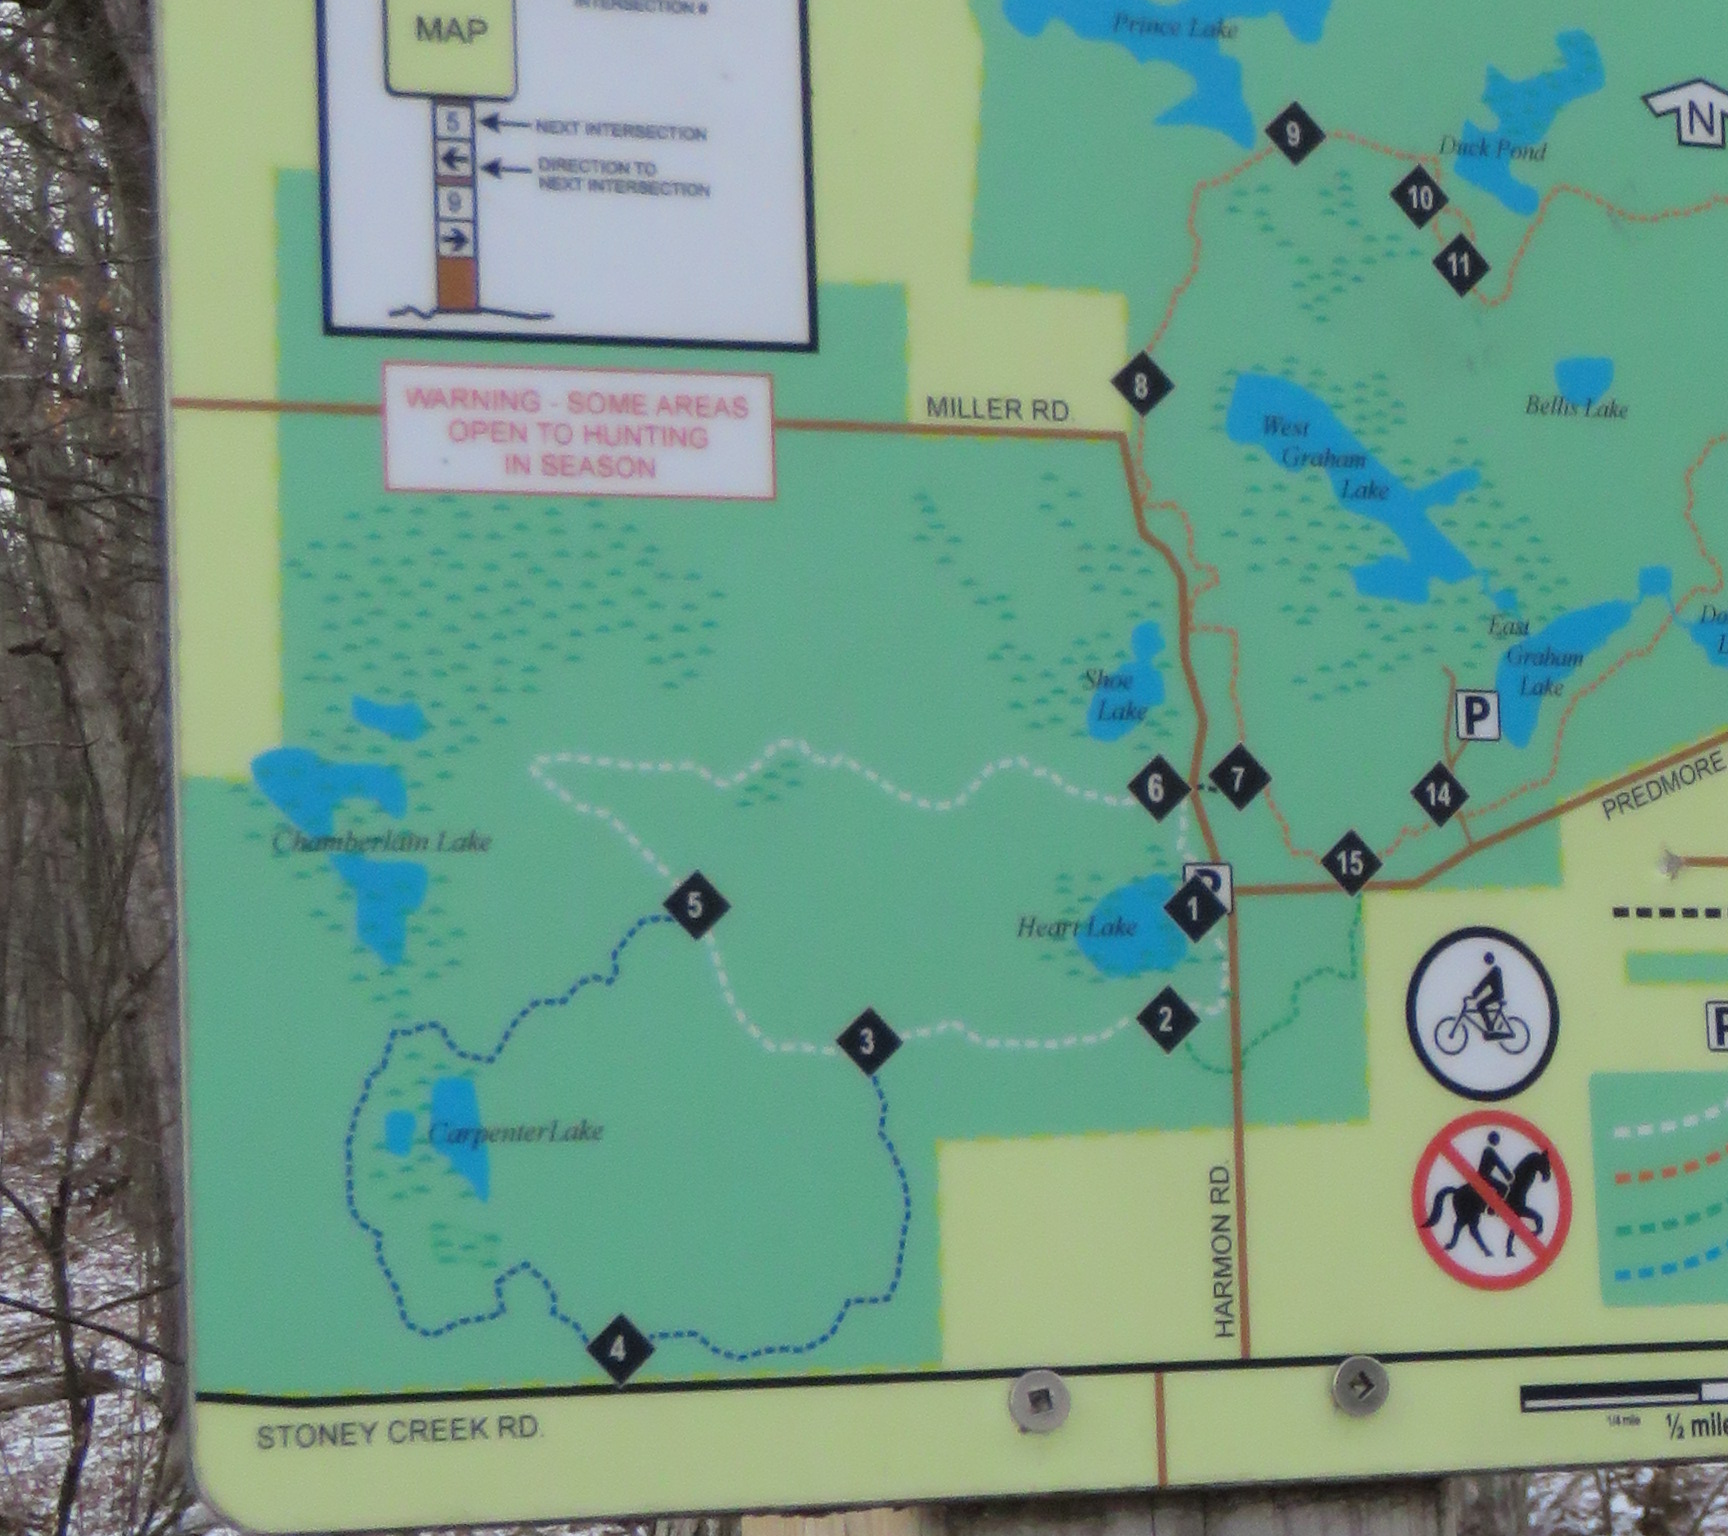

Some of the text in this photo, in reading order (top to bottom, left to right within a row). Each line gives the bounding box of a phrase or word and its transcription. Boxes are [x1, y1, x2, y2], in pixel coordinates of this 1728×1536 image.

[415, 15, 489, 45] MAP
[1111, 11, 1239, 40] Prince Lake
[445, 111, 460, 133] 5
[536, 119, 708, 141] NEXT INTERSECTION
[1688, 100, 1715, 136] N
[1287, 120, 1301, 147] 9
[1496, 138, 1548, 162] Pond
[538, 156, 658, 177] DIRECTION TO
[538, 176, 711, 198] NEXT INTERSECTION
[1407, 185, 1433, 211] 10
[1447, 252, 1470, 277] 11
[1134, 373, 1148, 400] 8
[405, 387, 542, 414] WARNING
[567, 390, 648, 416] SOME
[655, 394, 749, 419] AREAS
[926, 395, 1024, 421] MILLER
[1584, 396, 1630, 420] Lake
[447, 418, 710, 450] OPEN TO HUNTING
[1262, 413, 1311, 439] West
[505, 453, 657, 480] IN SEASON
[1281, 446, 1367, 471] Graham
[1341, 478, 1390, 501] Lake
[1489, 613, 1531, 636] East
[1506, 645, 1584, 668] Graham
[1083, 668, 1134, 691] Shoe
[1519, 677, 1564, 698] Lake
[1096, 699, 1148, 722] Lake
[1464, 696, 1491, 736] P
[1147, 773, 1164, 802] 6
[1231, 767, 1246, 793] 7
[1601, 749, 1727, 821] PREDMORE
[1425, 781, 1452, 808] 14
[435, 829, 493, 853] Lake
[1337, 851, 1364, 876] 15
[687, 891, 702, 919] 5
[1187, 895, 1198, 922] 1
[1017, 914, 1138, 939] Heart Lake
[1158, 1006, 1174, 1033] 2
[859, 1028, 875, 1055] 3
[1211, 1213, 1236, 1339] HARMON
[609, 1334, 626, 1362] 4
[255, 1420, 378, 1450] STONEY
[388, 1417, 490, 1444] CREEK
